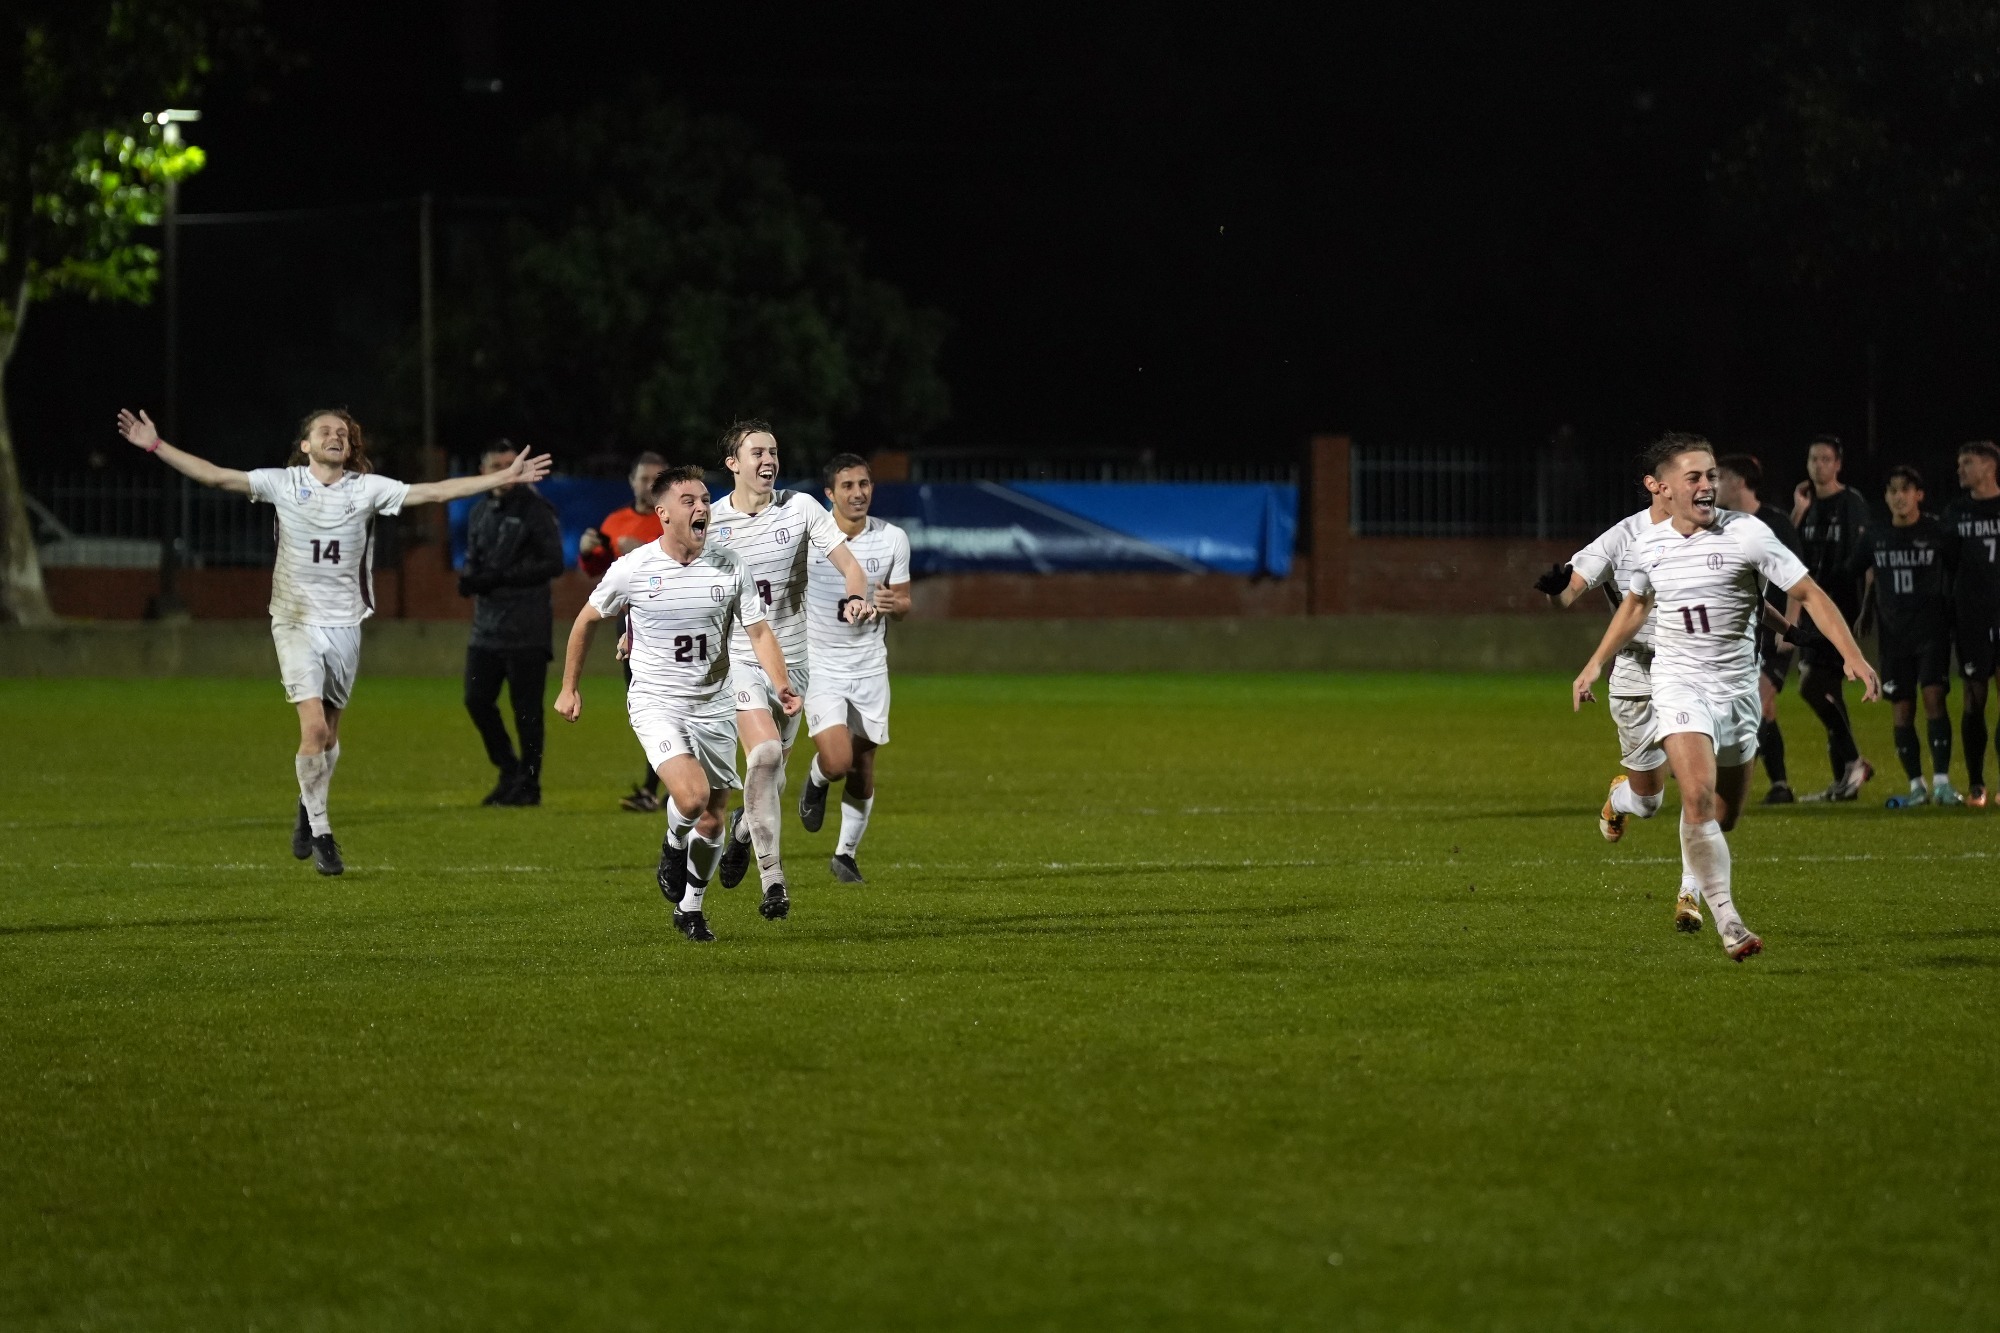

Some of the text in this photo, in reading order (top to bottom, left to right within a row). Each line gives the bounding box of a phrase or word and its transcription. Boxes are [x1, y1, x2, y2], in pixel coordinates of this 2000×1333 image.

[310, 540, 341, 564] 14
[1889, 549, 1934, 567] DALLAS
[1983, 538, 1996, 563] 7
[1893, 569, 1913, 594] 10
[1677, 604, 1710, 634] 11
[674, 633, 707, 662] 21
